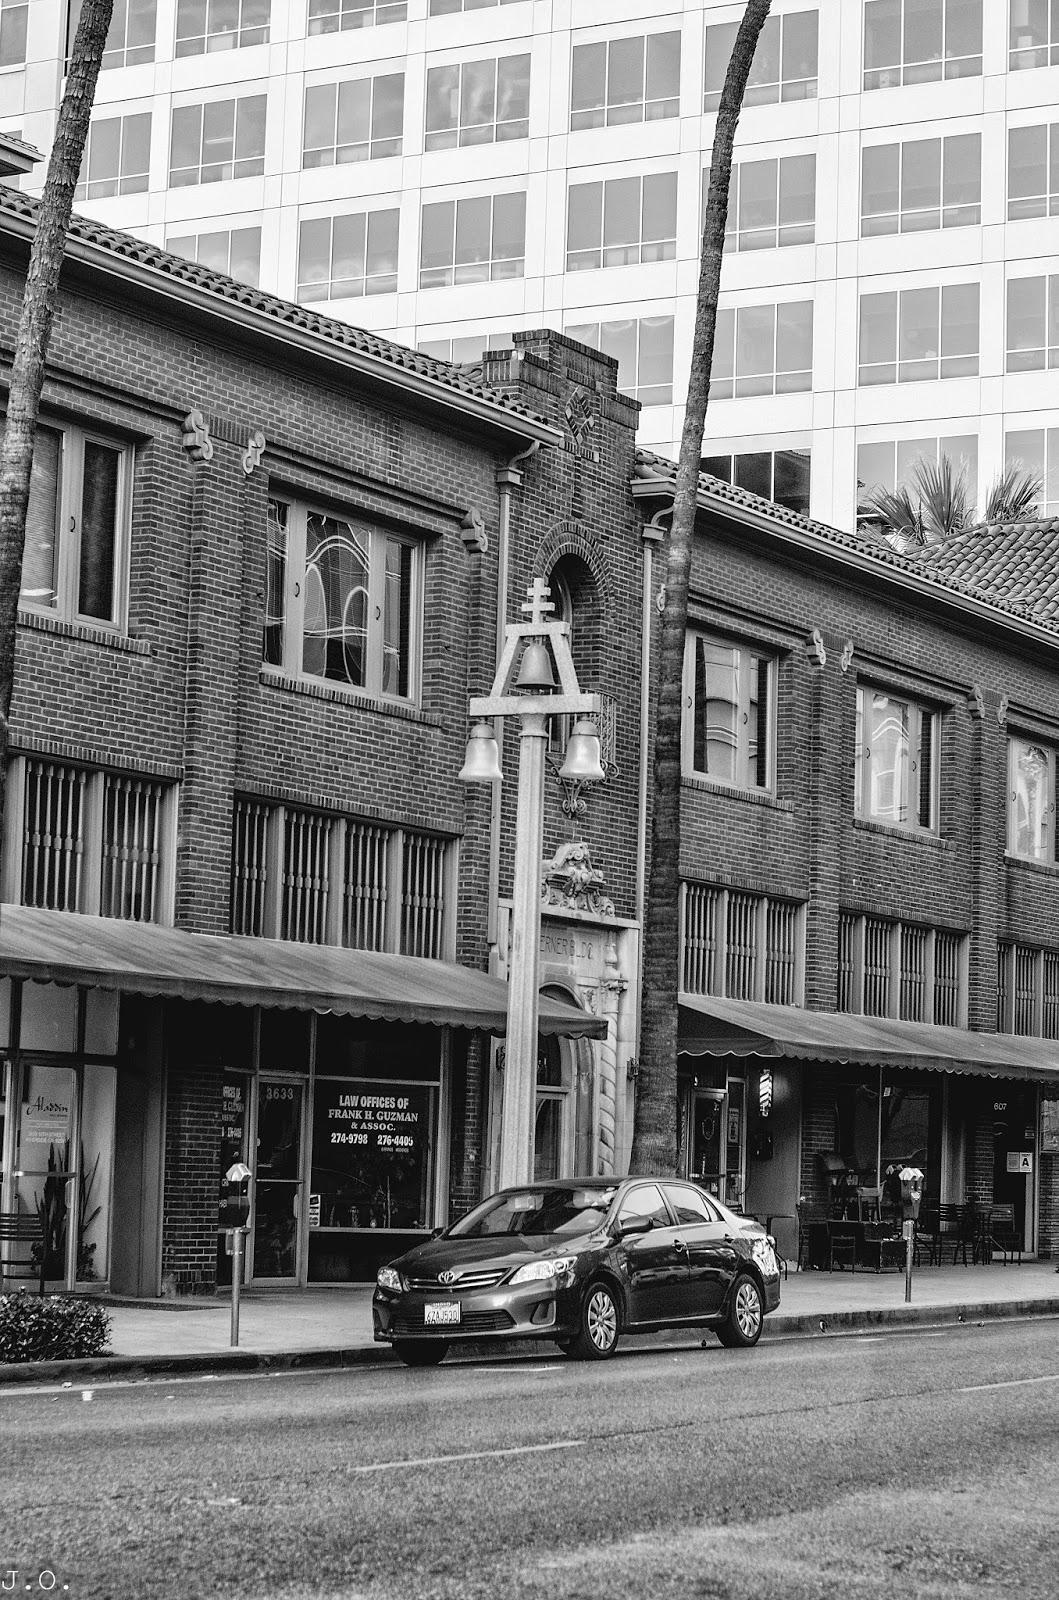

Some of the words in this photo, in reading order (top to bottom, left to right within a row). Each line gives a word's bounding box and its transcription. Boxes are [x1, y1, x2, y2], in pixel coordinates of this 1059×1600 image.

[266, 1087, 294, 1100] 3633
[26, 1096, 68, 1116] Aladdin
[339, 1095, 359, 1107] LAW
[360, 1096, 396, 1109] OFFICES
[397, 1098, 410, 1109] OF
[993, 1102, 1007, 1111] 607
[328, 1108, 363, 1120] FRANK
[364, 1110, 375, 1120] H.
[376, 1110, 418, 1122] GUZMAN
[350, 1121, 358, 1130] &
[360, 1121, 396, 1131] ASSOC.
[330, 1132, 369, 1145] 274-9798
[377, 1134, 414, 1147] 276-4405
[1021, 1157, 1030, 1167] A
